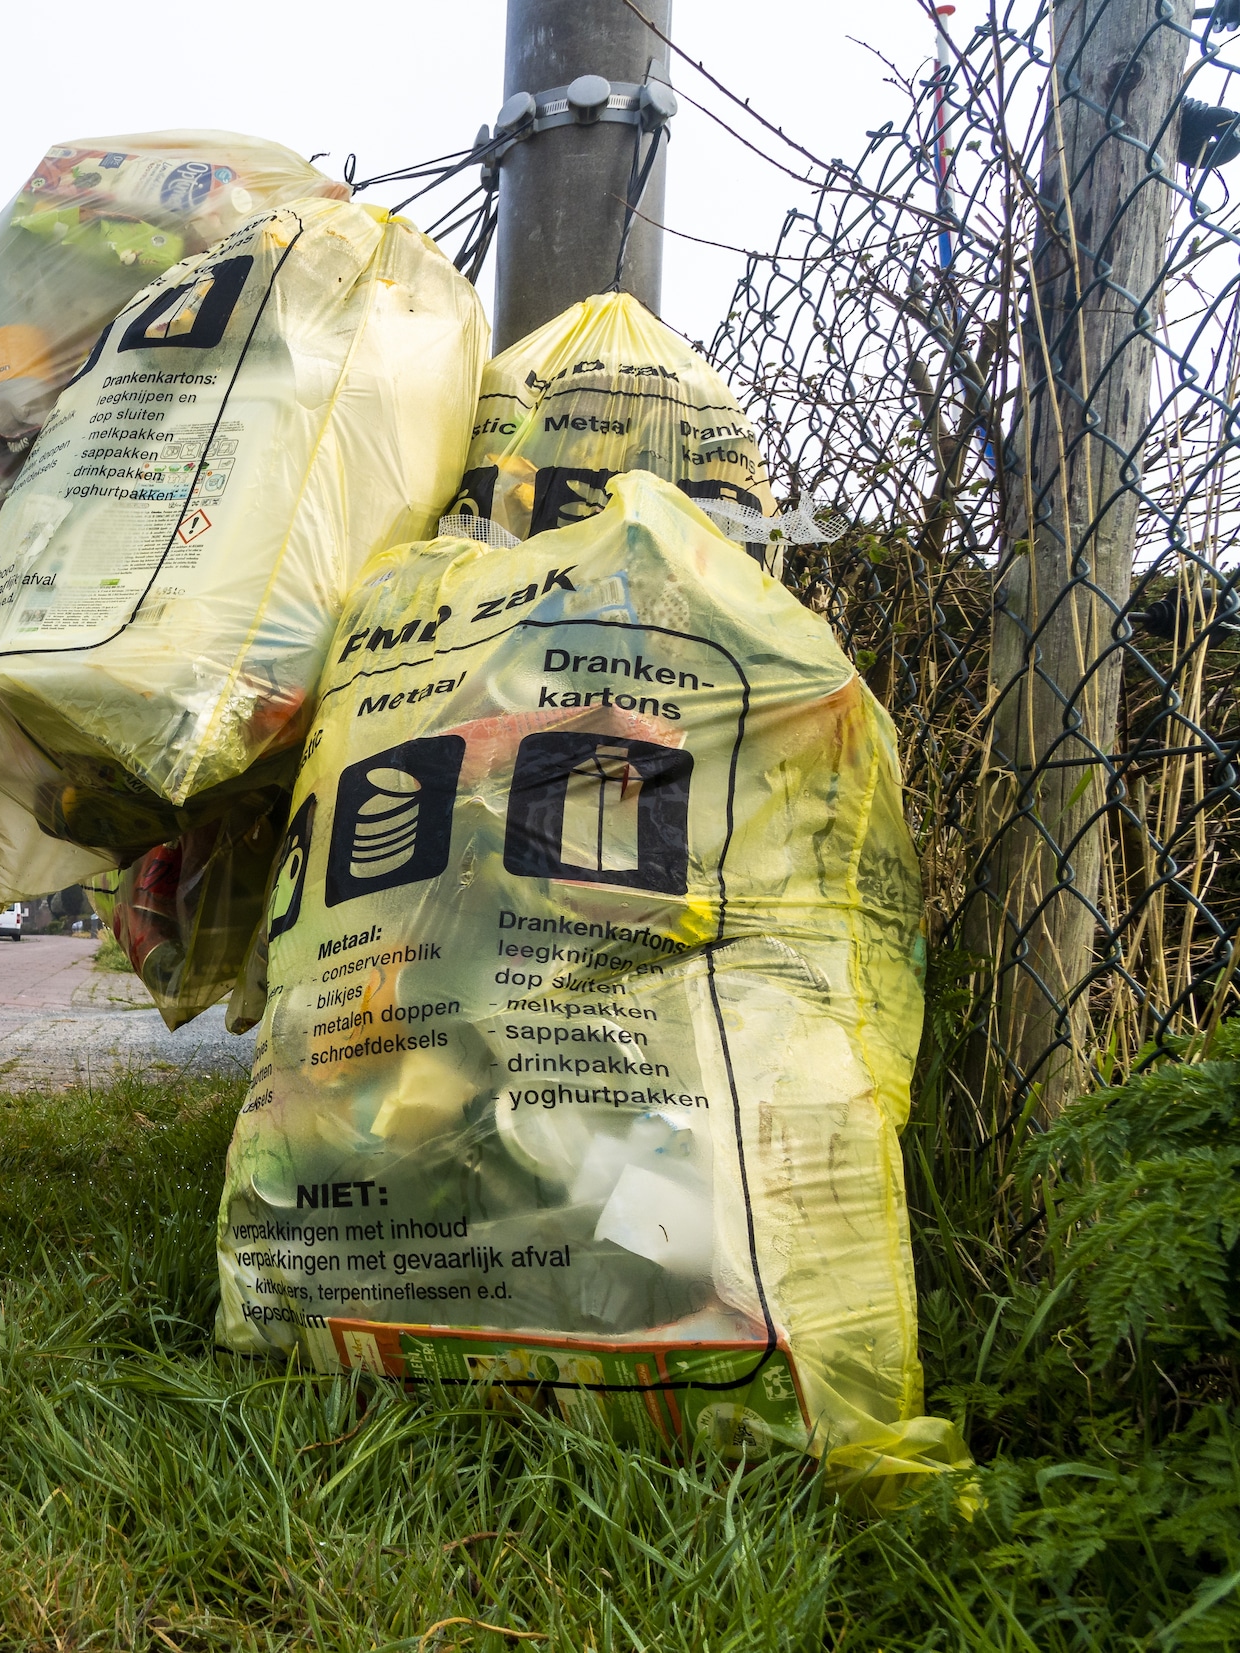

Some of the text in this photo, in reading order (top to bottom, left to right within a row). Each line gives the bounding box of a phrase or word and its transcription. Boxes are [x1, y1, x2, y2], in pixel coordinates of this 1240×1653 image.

[102, 371, 217, 389] Drankenkartons:
[96, 390, 197, 406] leegknijpen en
[89, 408, 165, 424] dop sluiten
[544, 414, 631, 436] Metaal
[88, 427, 175, 442] melkpakken
[80, 446, 159, 461] sappakken
[682, 445, 756, 475] kartons
[73, 465, 162, 481] drinkpakken
[64, 484, 174, 501] yoghurtpakken
[21, 572, 57, 586] afval
[357, 649, 715, 717] Metaal Dranken-
[538, 687, 681, 720] kartons
[318, 925, 382, 960] Metaal:
[322, 939, 664, 983] conservenblik leegknijpen en
[495, 968, 626, 995] dop sluiten
[317, 985, 657, 1021] blikjes melkpakken
[314, 1001, 648, 1046] metalen doppen sappakken
[311, 1030, 448, 1065] schroefdeksels
[507, 1053, 670, 1077] drinkpakken
[509, 1084, 709, 1111] yoghurtpakken
[296, 1181, 388, 1209] NIET:
[232, 1216, 468, 1246] verpakkingen met inhoud
[235, 1245, 571, 1276] verpakkingen met gevaarlijk afval
[318, 1281, 471, 1304] terpentineflessen
[477, 1281, 512, 1300] e.d.
